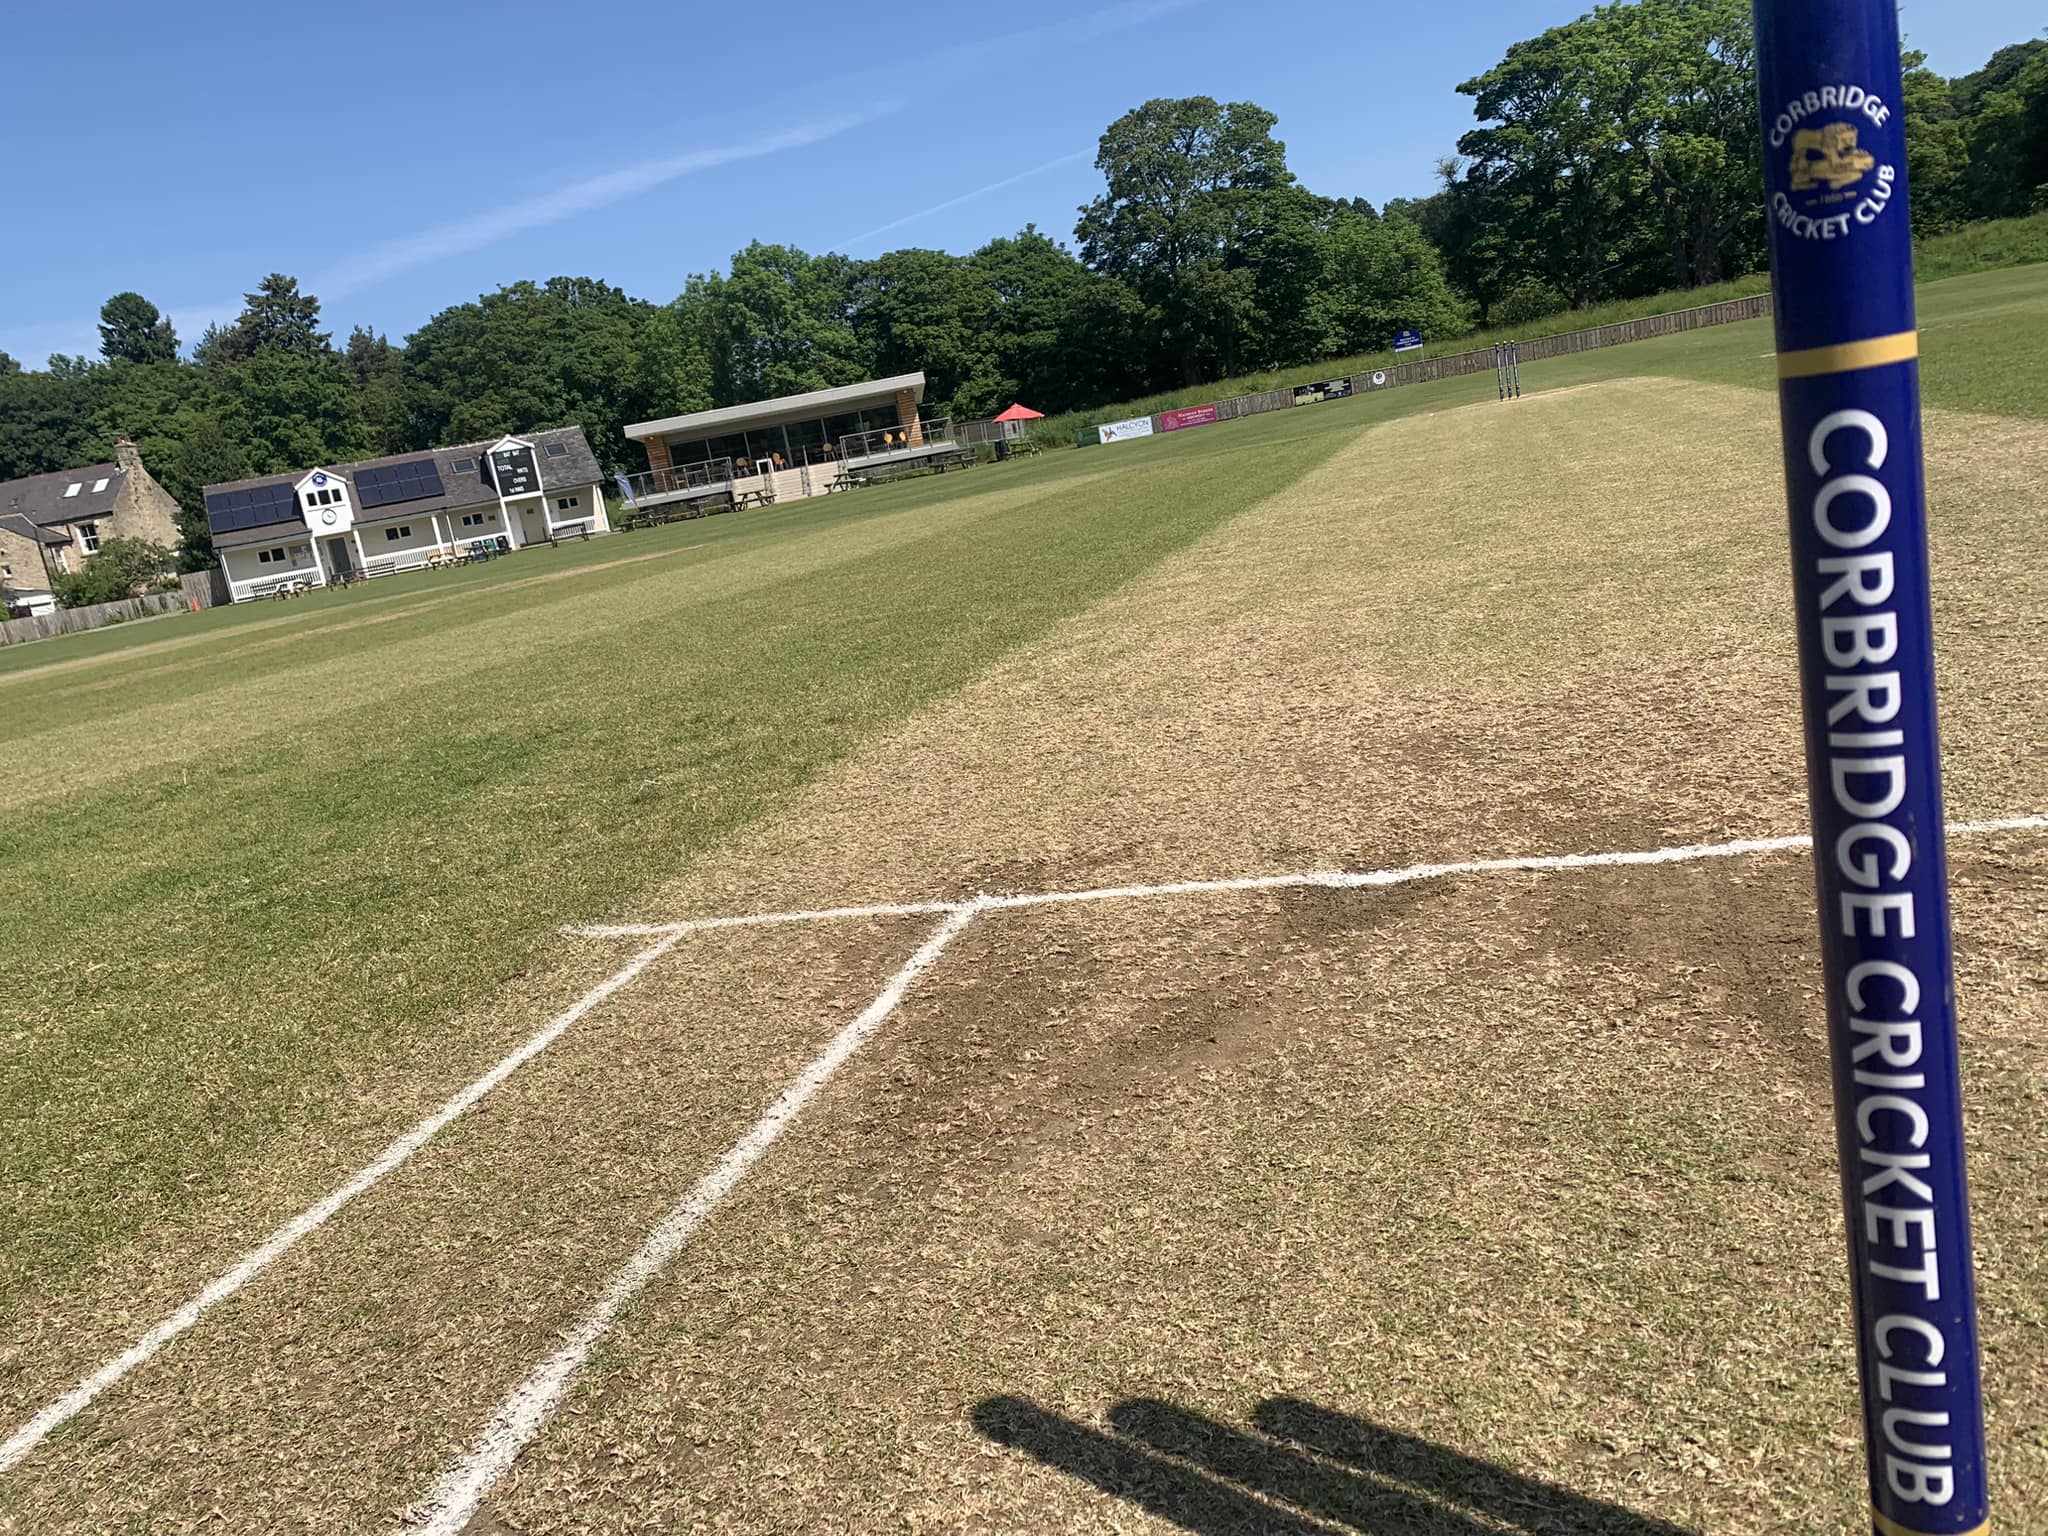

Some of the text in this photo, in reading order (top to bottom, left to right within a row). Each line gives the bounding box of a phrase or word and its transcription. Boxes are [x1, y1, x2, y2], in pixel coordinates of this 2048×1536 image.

[1769, 84, 1891, 148] CORBRIDGE
[1773, 163, 1896, 240] CRICKET CLUB
[1116, 419, 1150, 431] HALCYON
[1808, 407, 1956, 1508] CORBRIDGE CRICKET CLUB
